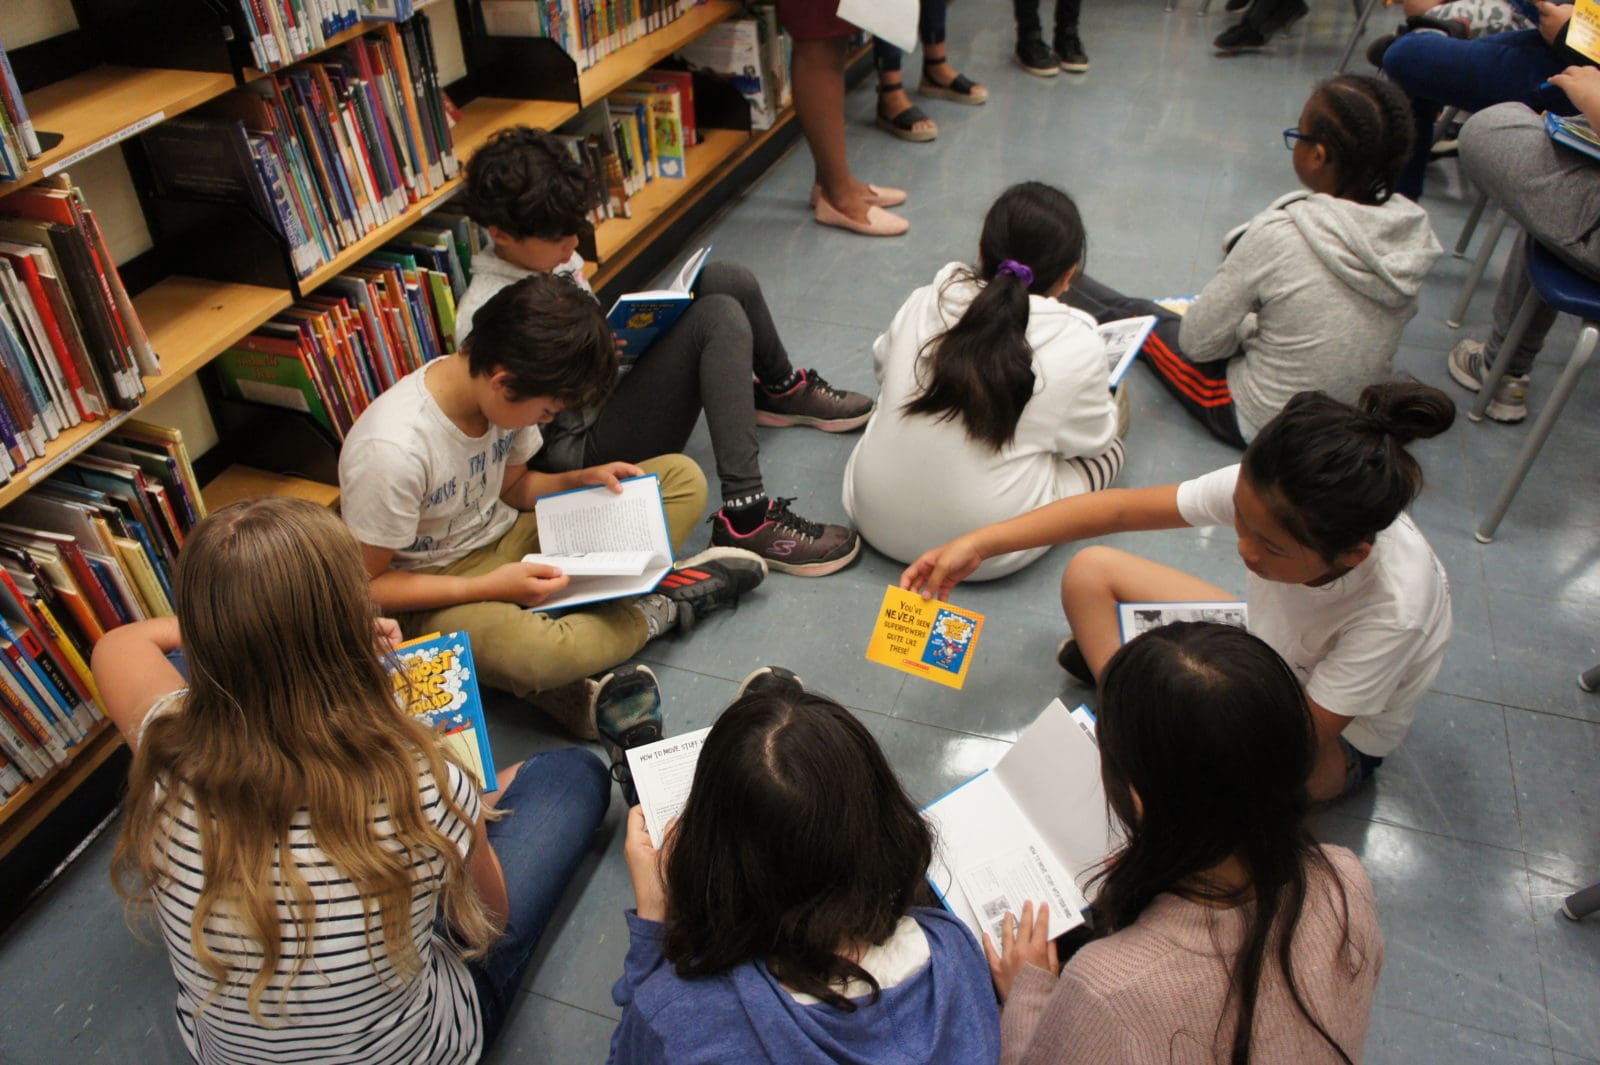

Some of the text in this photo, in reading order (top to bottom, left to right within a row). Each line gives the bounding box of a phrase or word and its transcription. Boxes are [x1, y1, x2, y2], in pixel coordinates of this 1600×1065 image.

[885, 608, 915, 624] NEVER
[916, 619, 931, 629] SEEN
[884, 621, 926, 639] SUPERPOWERS
[886, 633, 904, 643] QUITE
[640, 753, 653, 763] HOW
[654, 751, 663, 760] TO
[663, 745, 681, 758] MOVE
[681, 740, 698, 752] STUFF
